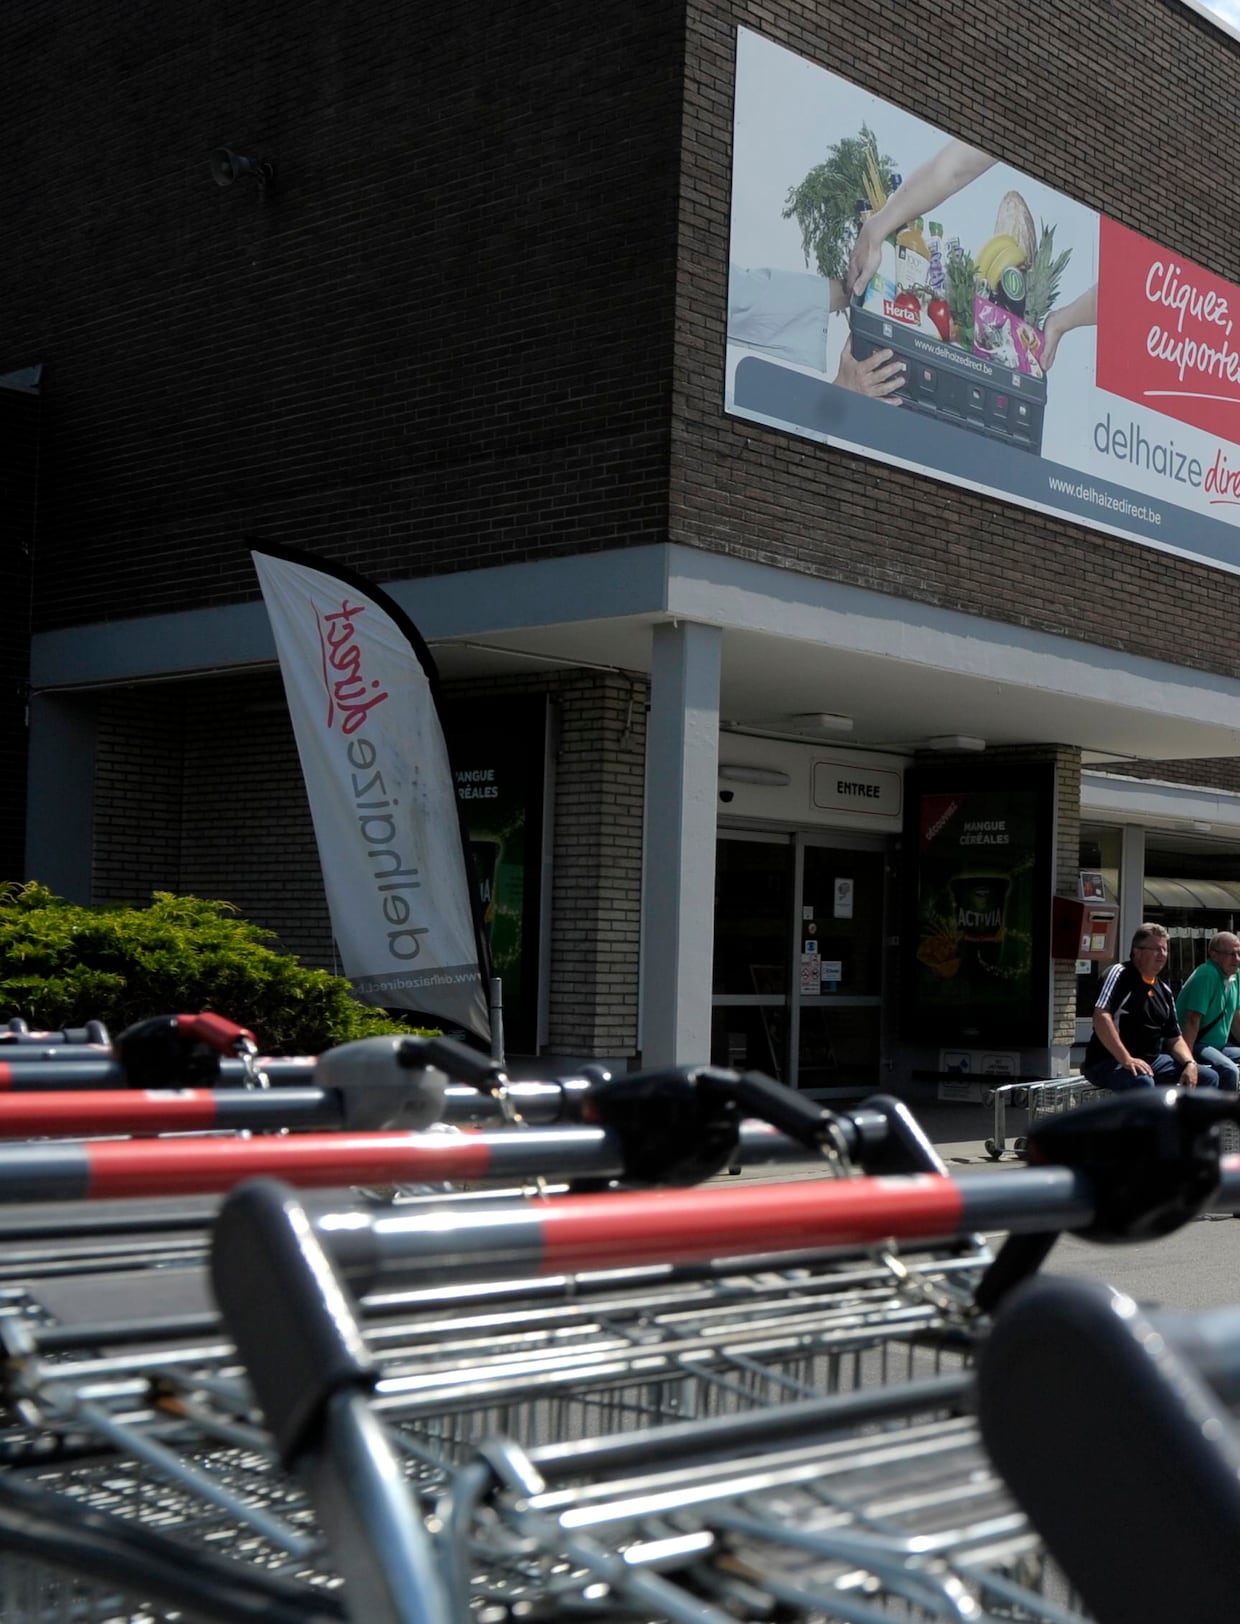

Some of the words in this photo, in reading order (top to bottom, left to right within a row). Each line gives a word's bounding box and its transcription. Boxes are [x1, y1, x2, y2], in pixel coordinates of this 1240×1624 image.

[1145, 261, 1233, 335] Cliquez,
[885, 303, 915, 321] Herta
[914, 338, 993, 376] www.delhaizedirect.be
[1048, 476, 1161, 525] www.delhaizedirect.be
[455, 769, 495, 782] ANGUE
[457, 784, 499, 799] RÉALES
[837, 781, 880, 798] ENTREE
[963, 820, 1006, 832] MANGUE
[959, 832, 1010, 845] CÉRÉALES
[958, 907, 1001, 927] ACTIVIA
